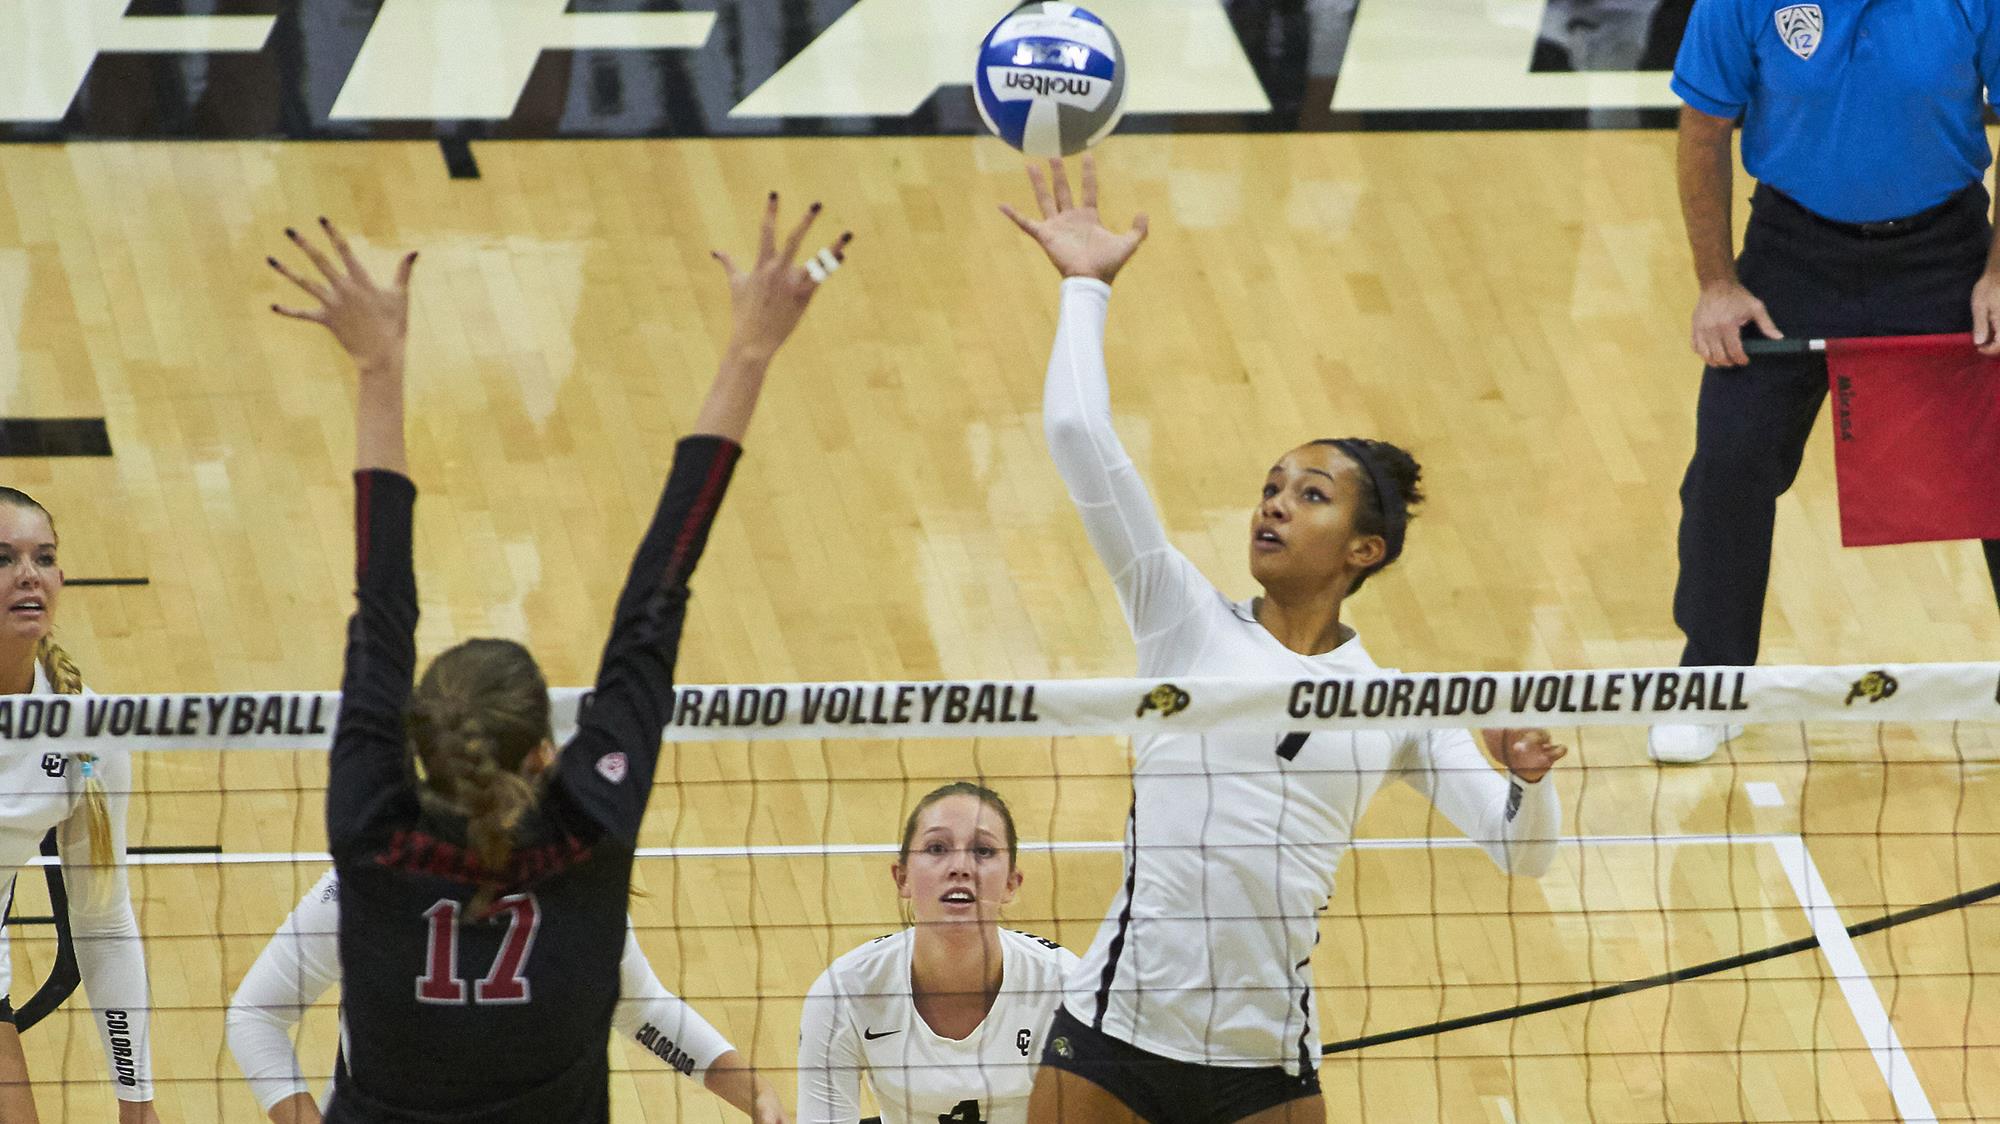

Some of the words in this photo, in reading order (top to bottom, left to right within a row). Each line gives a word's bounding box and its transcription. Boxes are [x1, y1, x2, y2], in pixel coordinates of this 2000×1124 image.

[1794, 33, 1813, 49] 12
[1006, 71, 1091, 96] molten
[83, 694, 326, 738] VOLLEYBALL
[801, 684, 1039, 725] VOLLEYBALL
[1288, 676, 1497, 719] COLORADO
[1510, 671, 1749, 713] VOLLEYBALL
[415, 892, 542, 1005] 17
[105, 1009, 136, 1087] COLORADO
[635, 1022, 696, 1077] COLORADO
